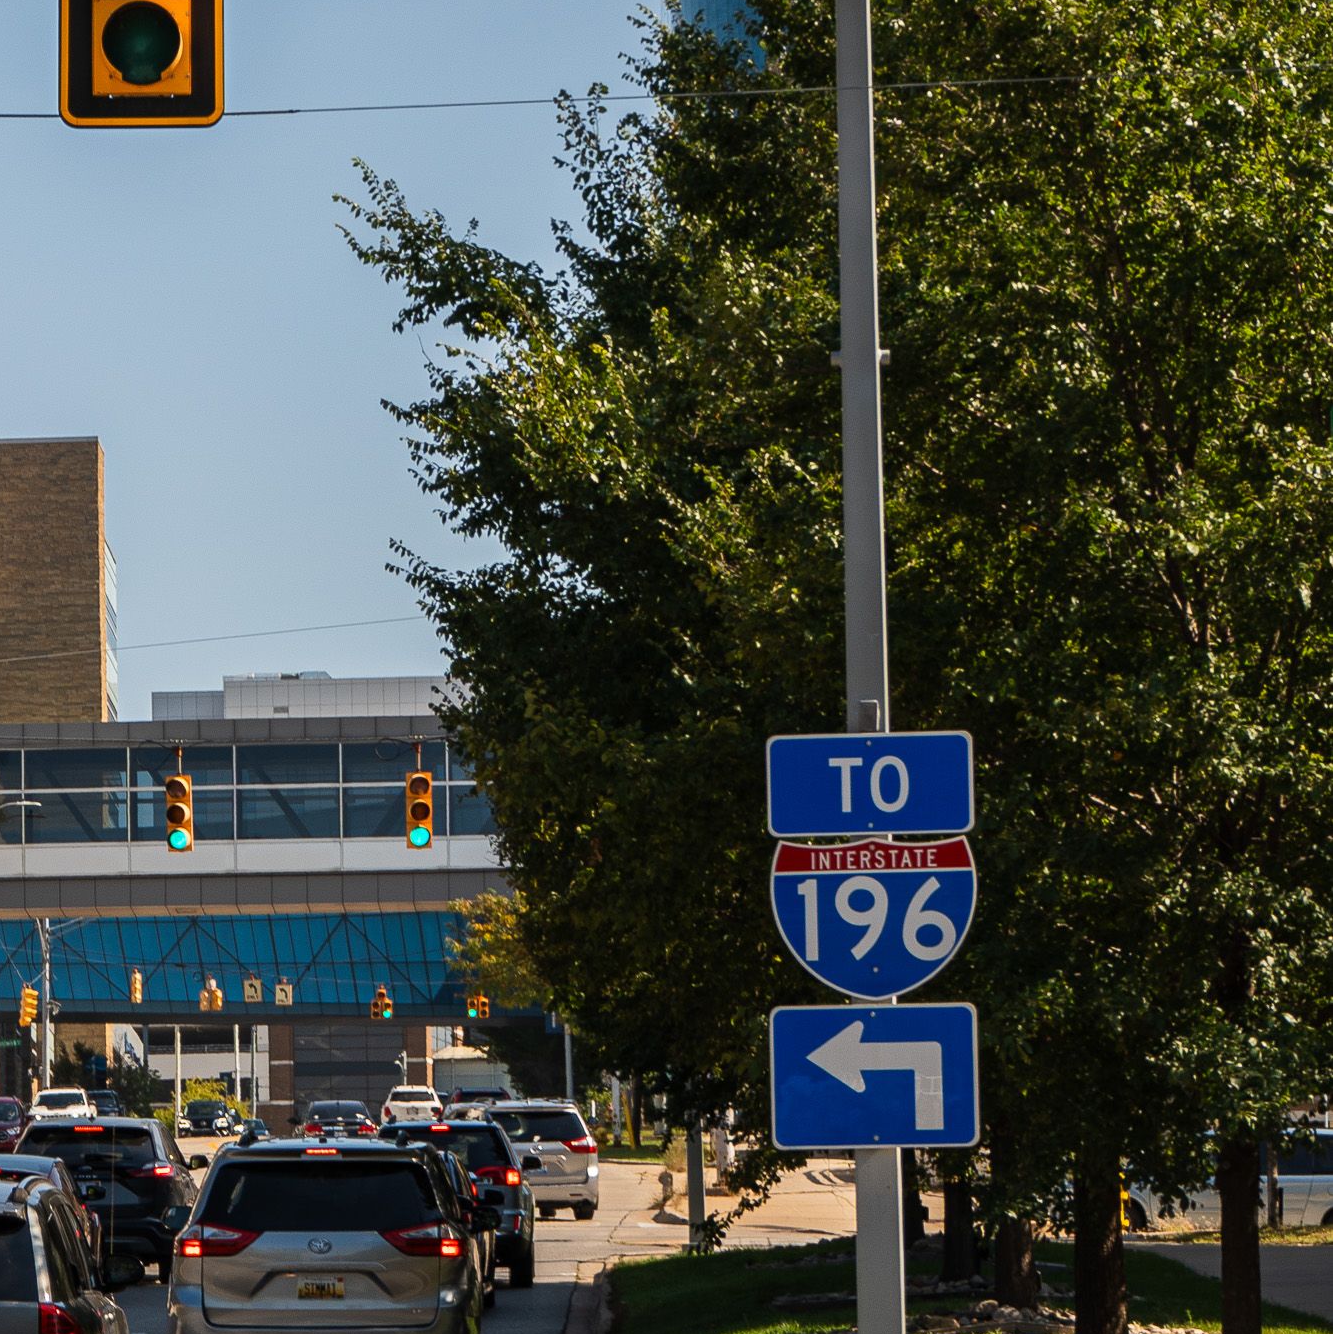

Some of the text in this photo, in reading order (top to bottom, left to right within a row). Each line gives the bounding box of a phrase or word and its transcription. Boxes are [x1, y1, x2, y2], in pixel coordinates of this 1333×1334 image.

[828, 755, 910, 813] TO
[810, 849, 938, 870] INTERSTATE
[797, 875, 957, 962] 196
